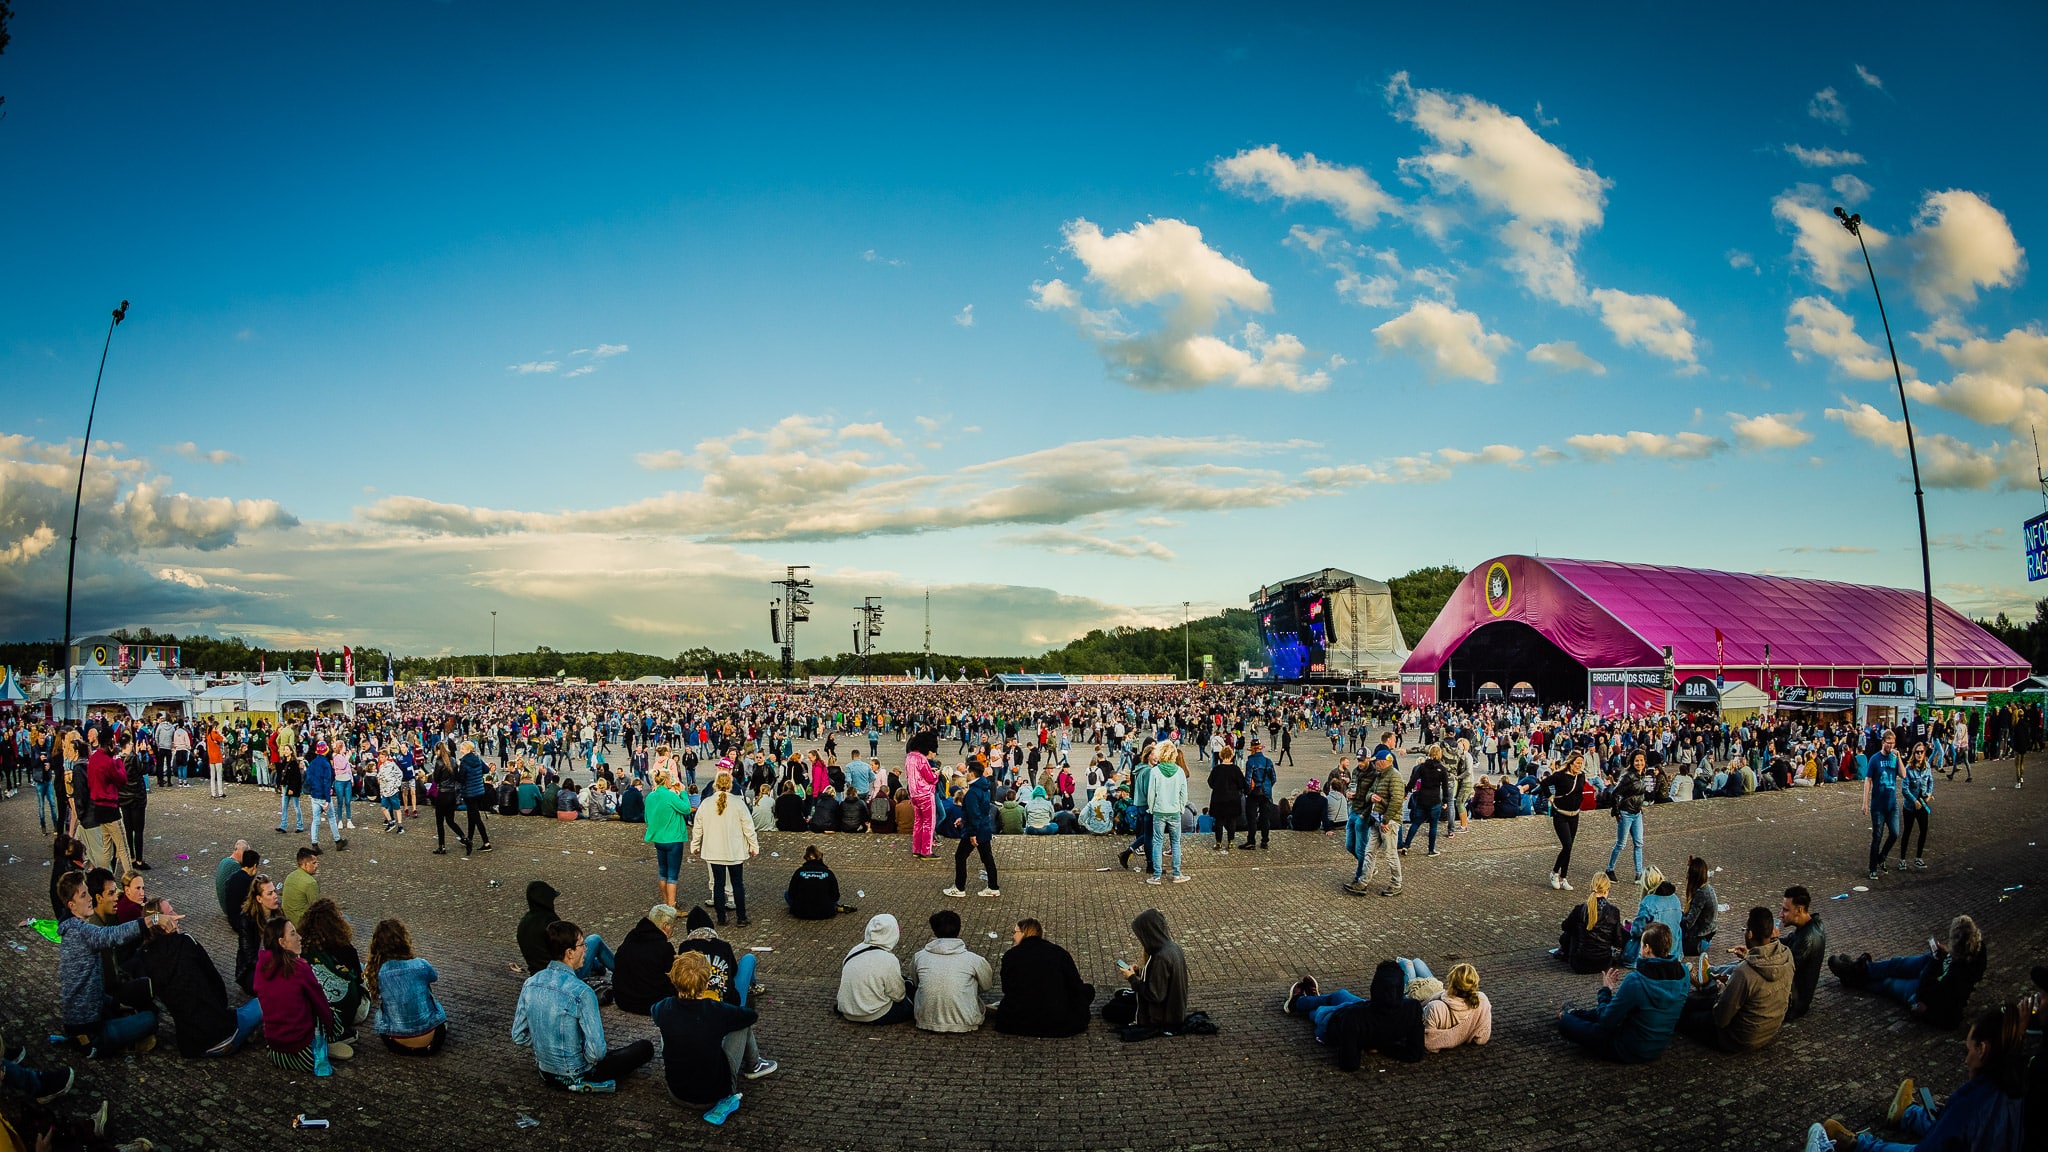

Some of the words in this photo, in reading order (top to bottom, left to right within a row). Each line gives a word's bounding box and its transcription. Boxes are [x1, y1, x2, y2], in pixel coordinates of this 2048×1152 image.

[2026, 550, 2048, 579] RAG
[1638, 674, 1660, 684] STAGE
[366, 687, 383, 697] BAR
[1685, 683, 1707, 696] BAR
[1879, 681, 1897, 693] INFO
[1783, 686, 1807, 701] Coffee
[1822, 691, 1854, 700] APOTHEEK
